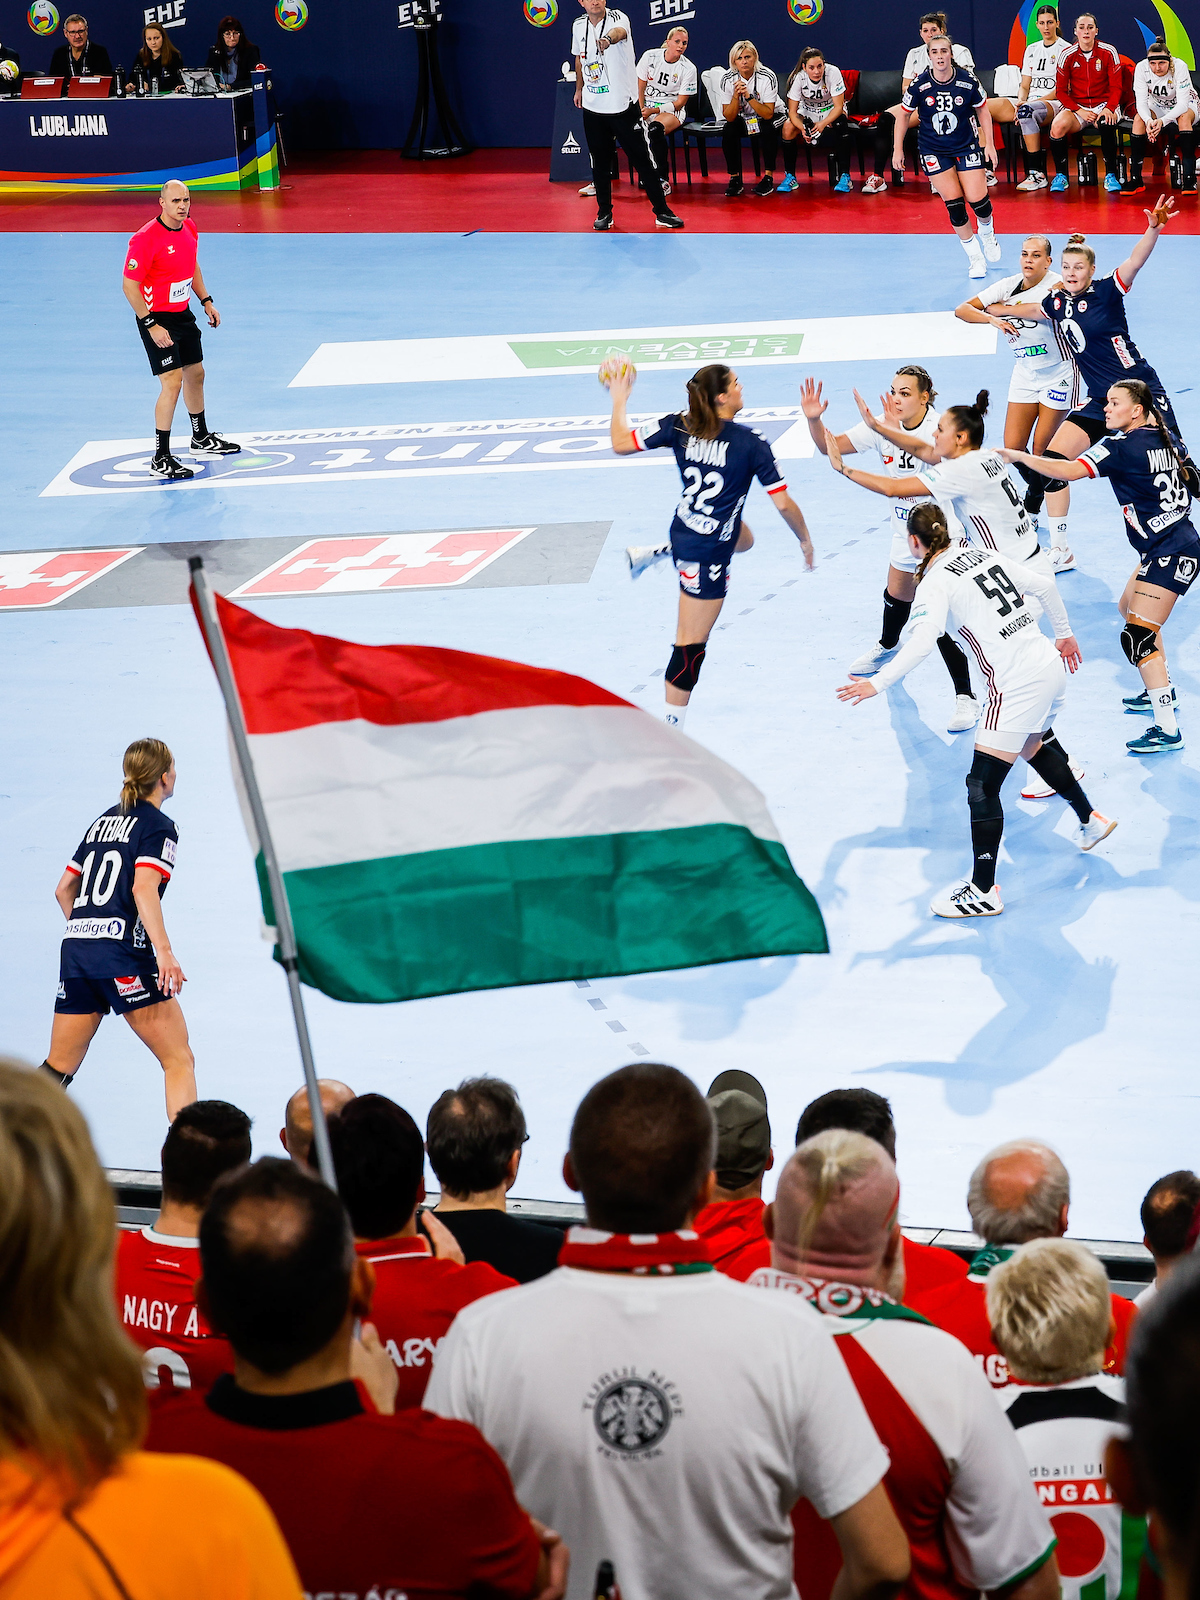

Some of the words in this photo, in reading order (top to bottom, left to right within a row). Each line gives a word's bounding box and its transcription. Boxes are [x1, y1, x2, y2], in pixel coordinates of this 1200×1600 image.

[144, 0, 186, 26] EHF
[650, 0, 694, 20] EHF
[658, 71, 669, 87] 15
[1152, 85, 1168, 97] 44
[936, 95, 953, 112] 33
[29, 114, 109, 137] LJUBLJANA
[246, 427, 434, 443] NETWORK
[309, 436, 612, 470] oint
[682, 465, 725, 516] 22
[972, 564, 1025, 618] 59
[85, 815, 139, 844] OFTEDAL
[73, 849, 123, 909] 10
[65, 920, 107, 936] nsidige
[123, 1293, 178, 1333] NAGY
[1029, 1463, 1075, 1477] dball
